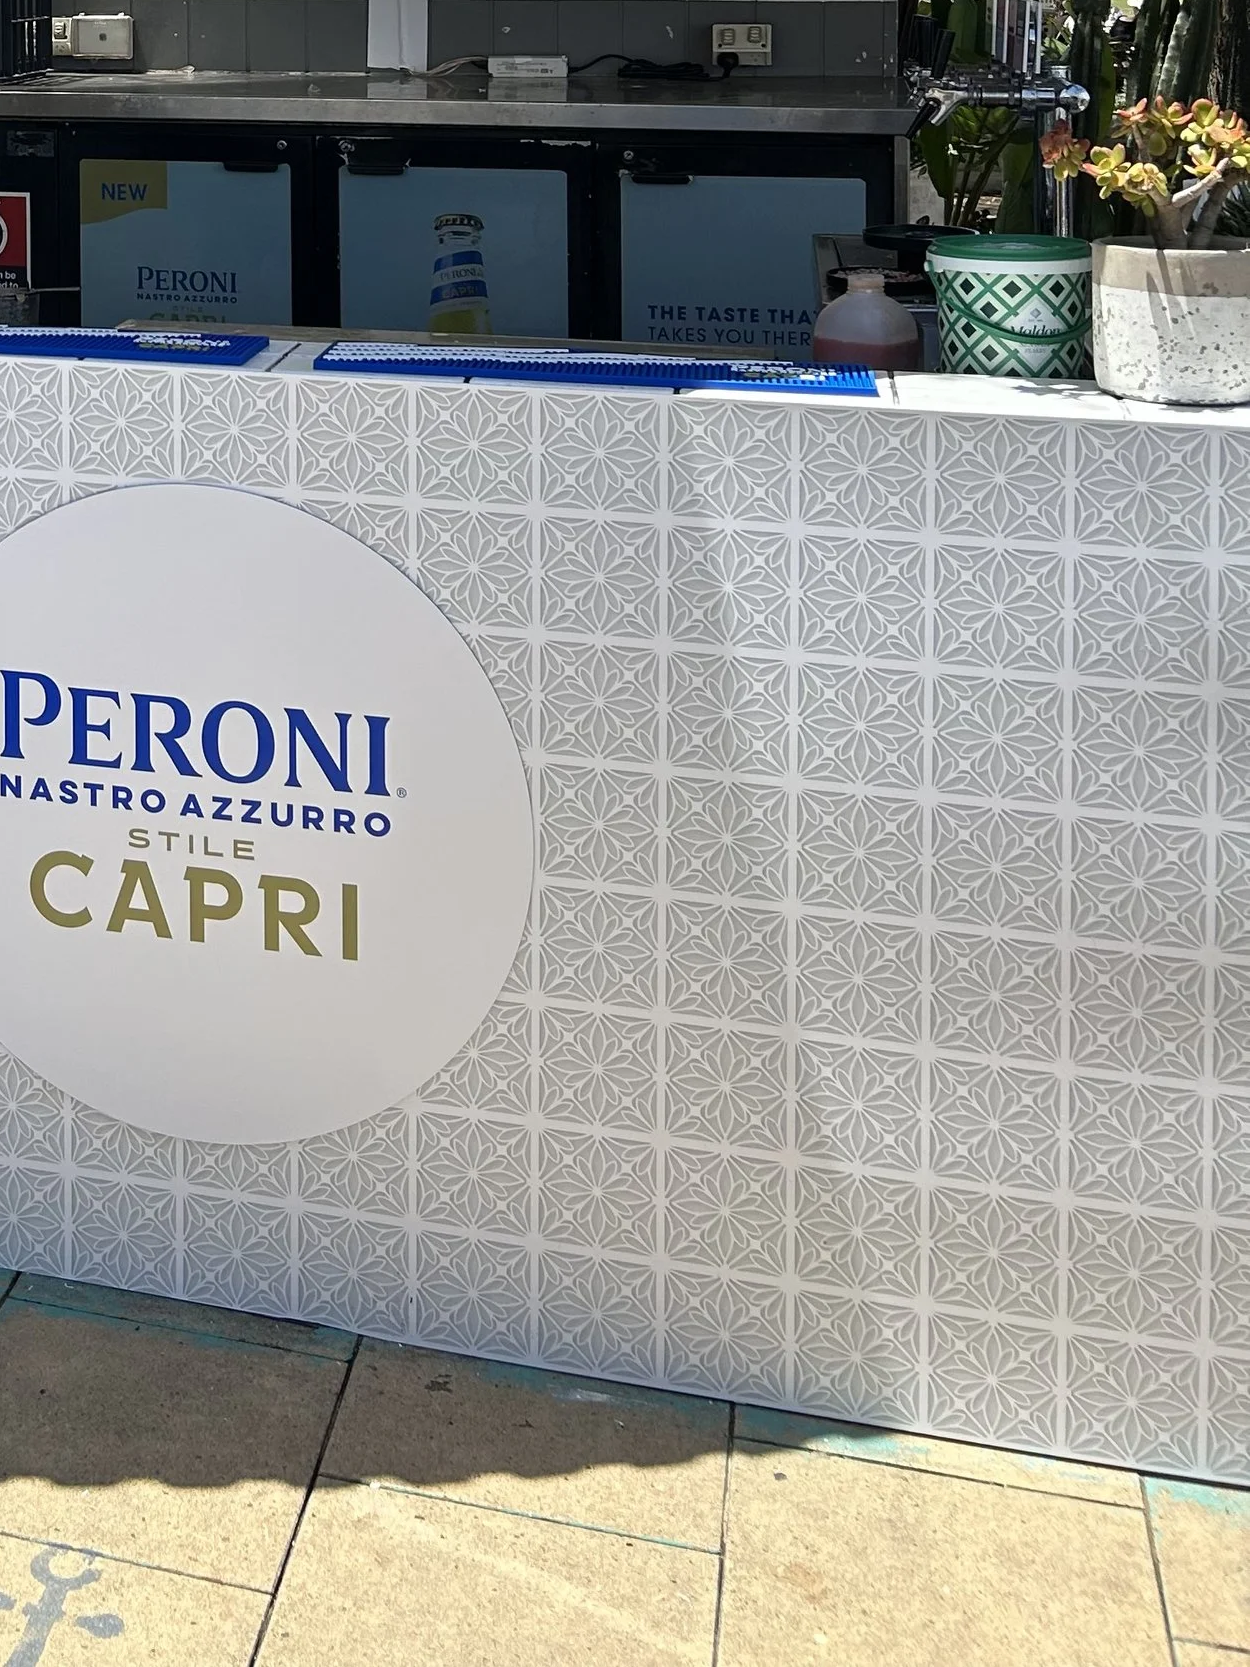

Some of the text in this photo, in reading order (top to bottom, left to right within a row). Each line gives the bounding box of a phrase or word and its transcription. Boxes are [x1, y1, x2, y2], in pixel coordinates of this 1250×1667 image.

[101, 183, 148, 201] NEW
[4, 271, 16, 279] be
[137, 266, 238, 293] PERONI
[137, 293, 237, 304] NASTRO AZZURRO
[648, 305, 817, 325] THE TASTE THA
[648, 326, 811, 346] TAKES YOU THER
[0, 670, 391, 797] PERONI
[0, 774, 391, 837] NASTRO AZZURRO
[128, 828, 255, 861] STILE
[30, 851, 358, 961] CAPRI
